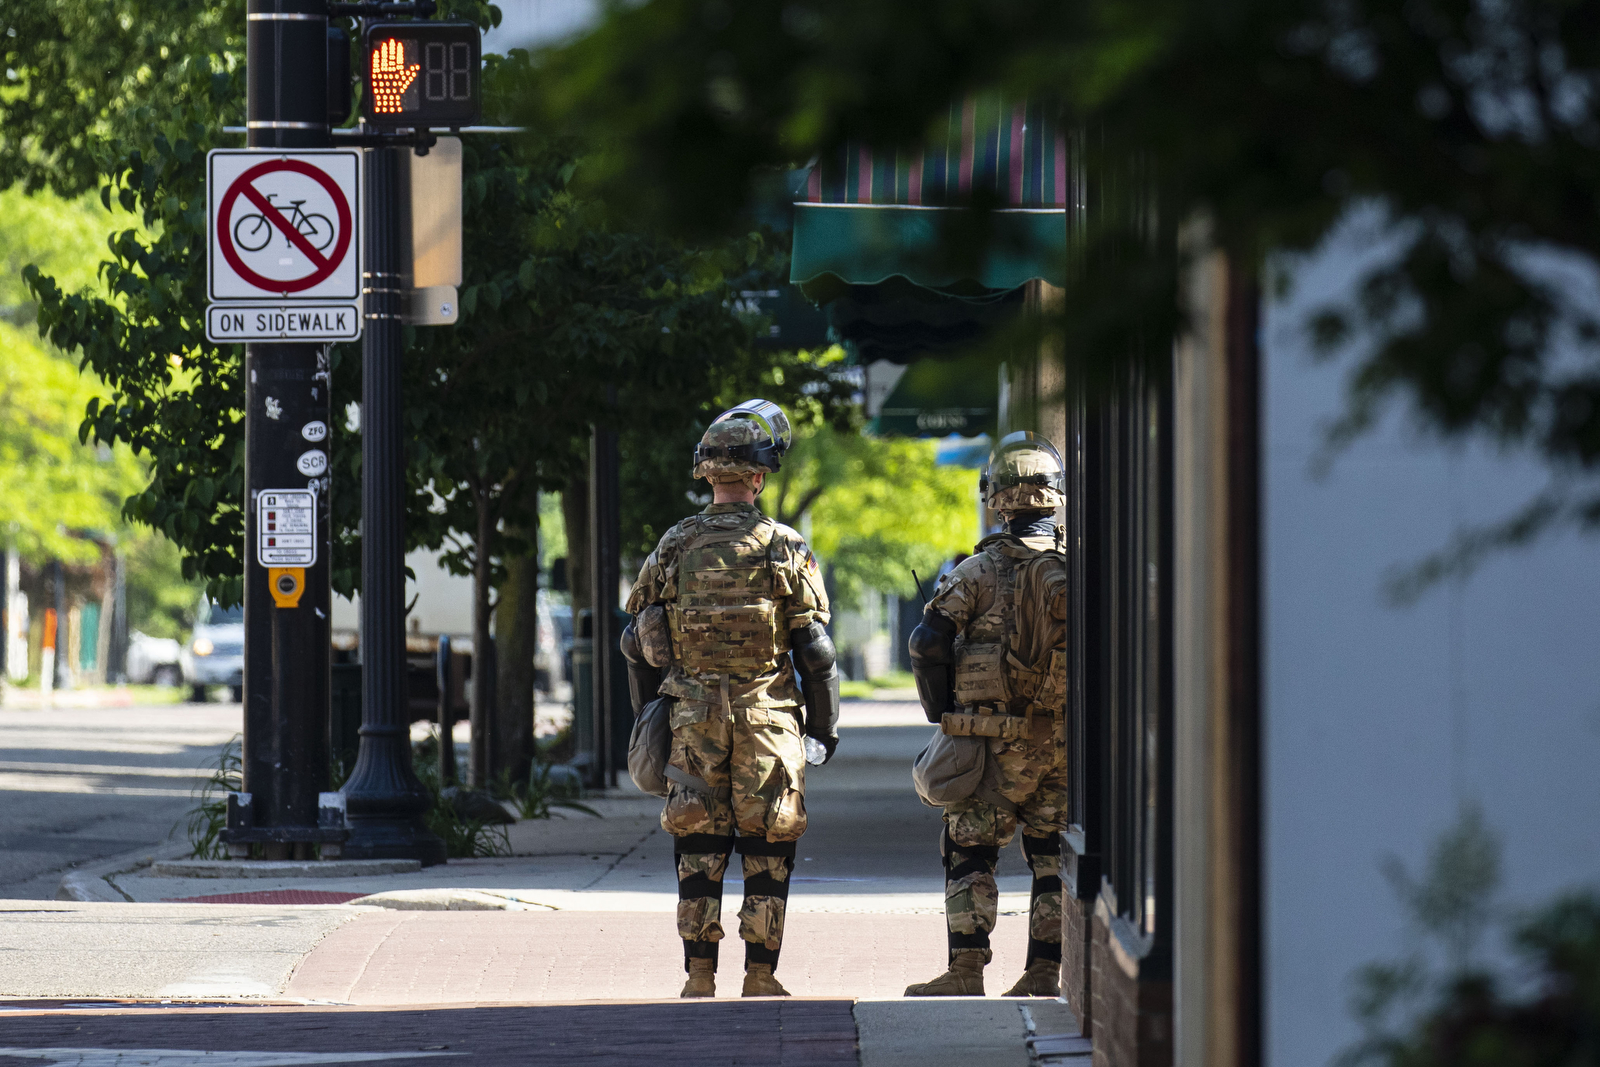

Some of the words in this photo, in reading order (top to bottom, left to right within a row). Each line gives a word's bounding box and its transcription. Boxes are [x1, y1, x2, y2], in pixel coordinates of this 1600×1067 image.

[220, 314, 244, 332] ON
[256, 312, 346, 332] SIDEWALK
[302, 455, 325, 470] SCR
